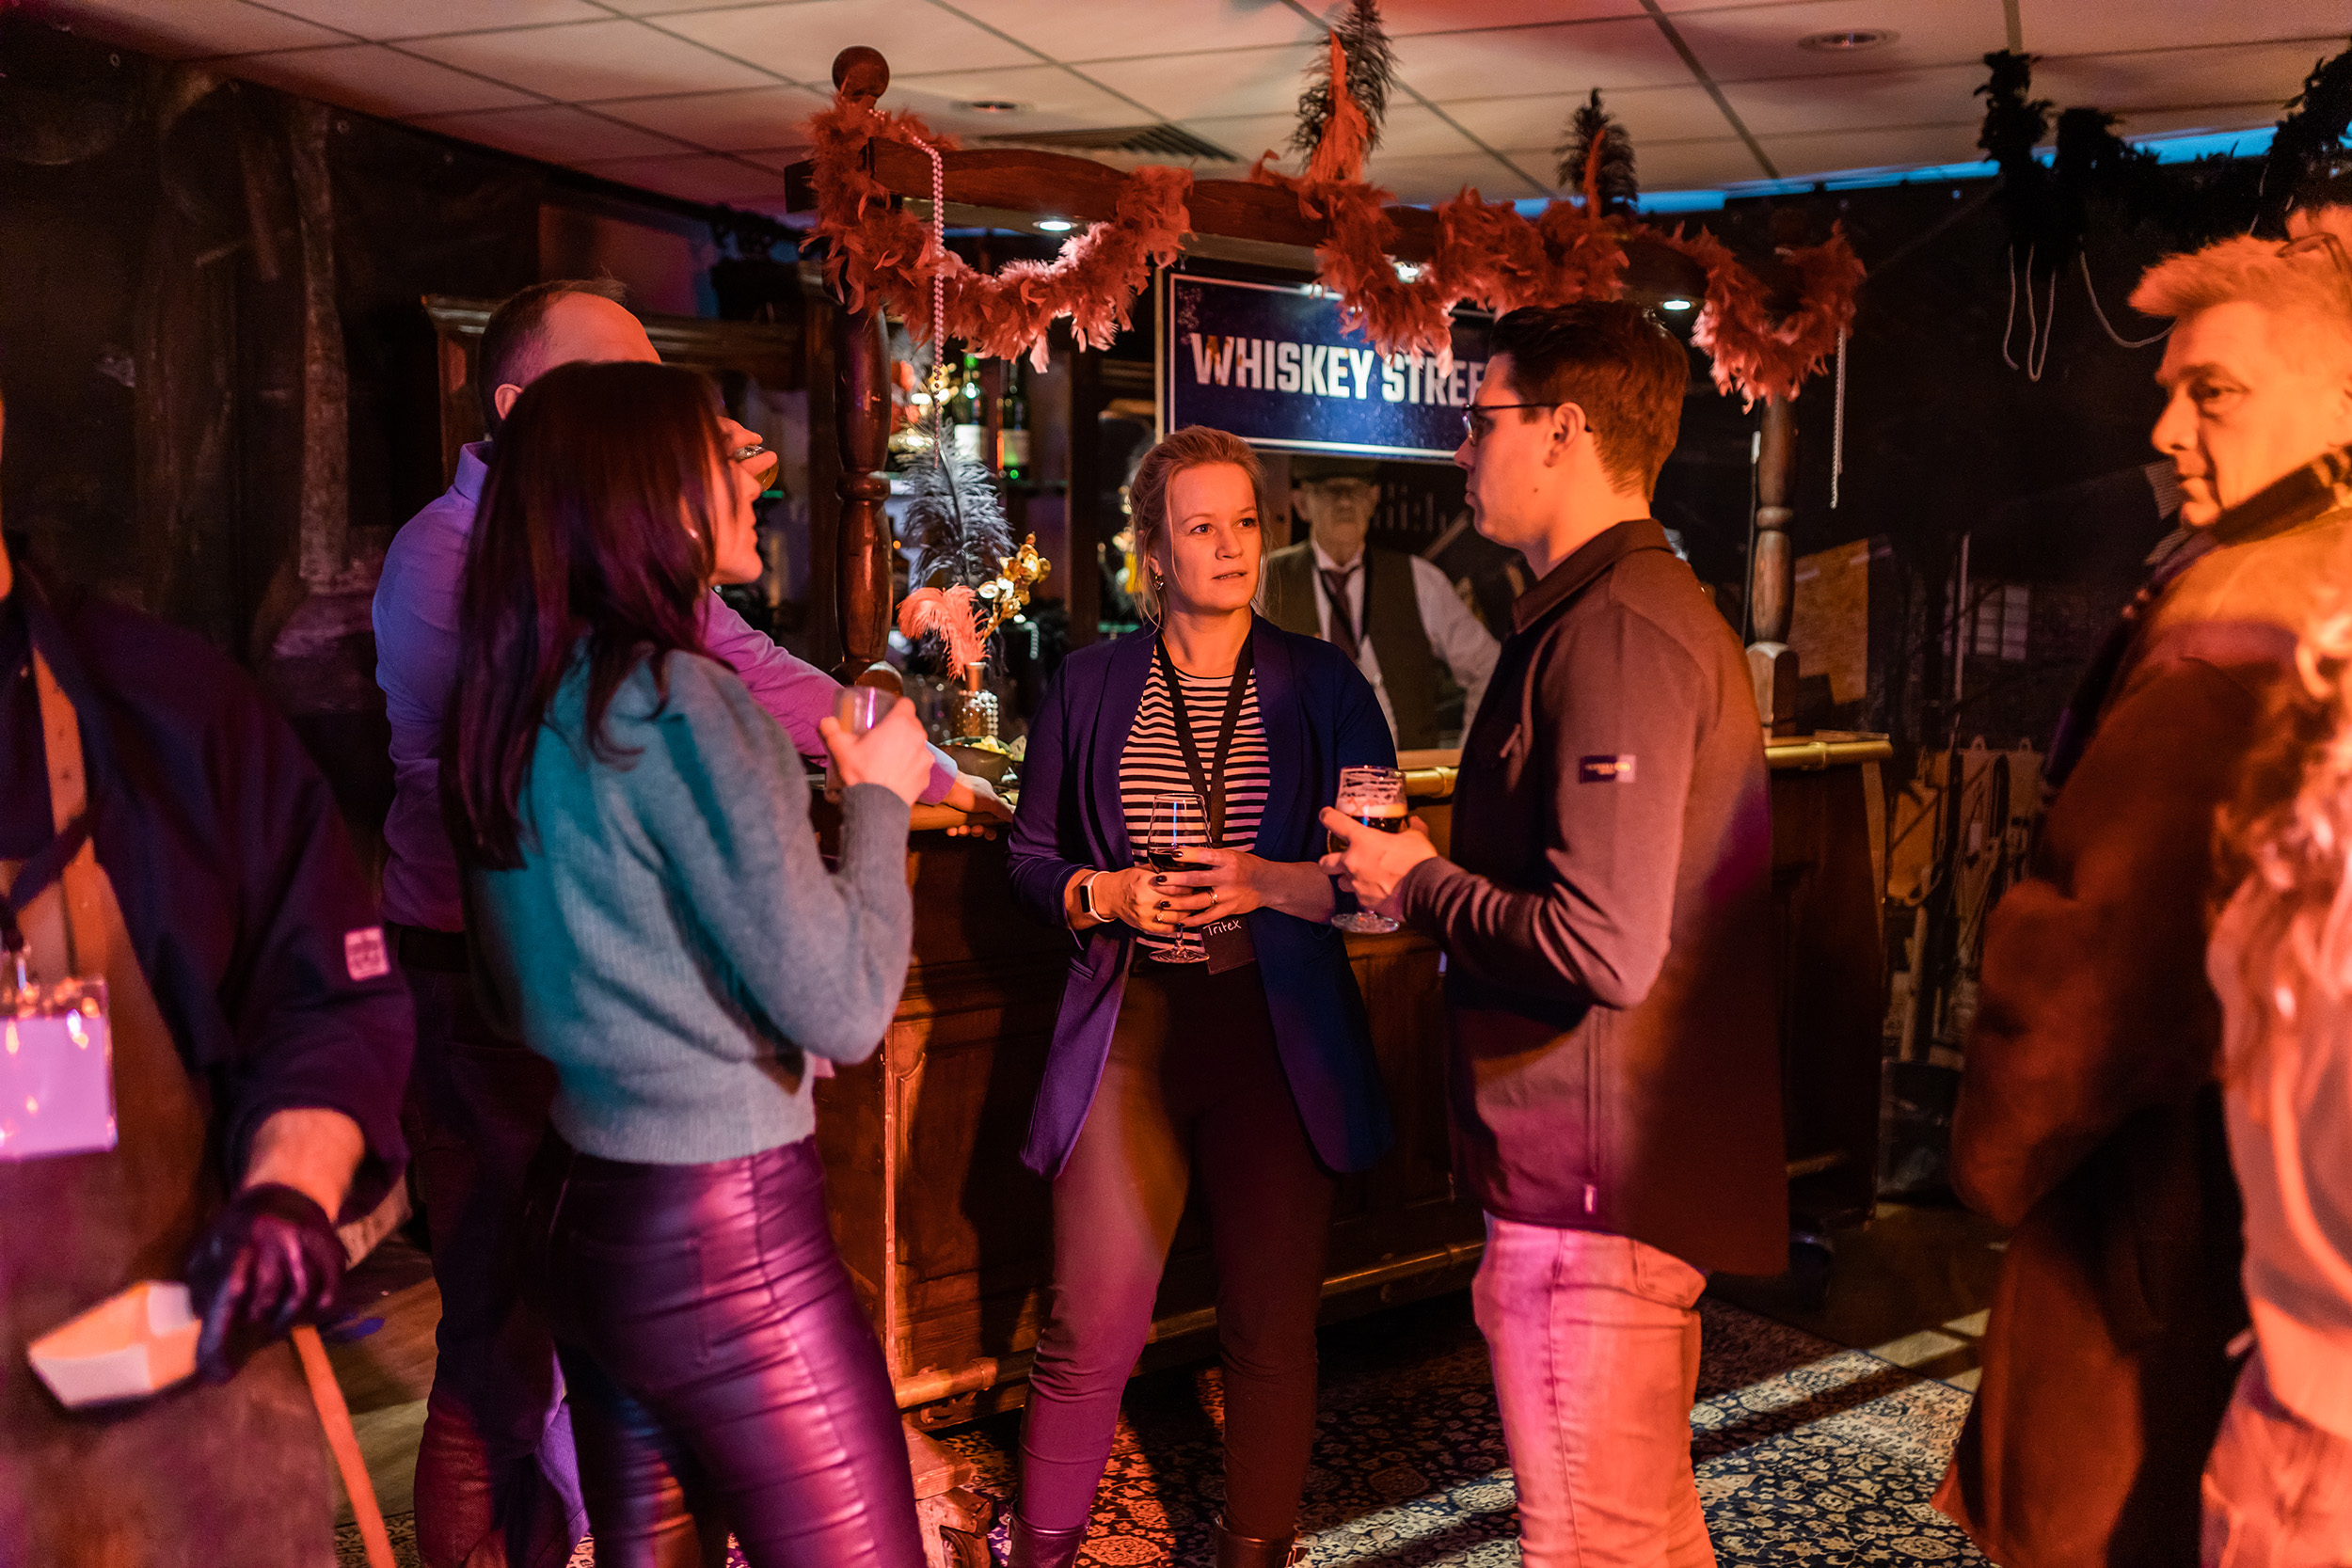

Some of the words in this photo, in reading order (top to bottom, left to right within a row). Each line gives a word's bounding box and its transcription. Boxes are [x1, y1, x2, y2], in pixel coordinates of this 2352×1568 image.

[1191, 333, 1374, 400] WHISKEY
[1381, 355, 1486, 407] STREE
[1202, 919, 1242, 936] Tritex
